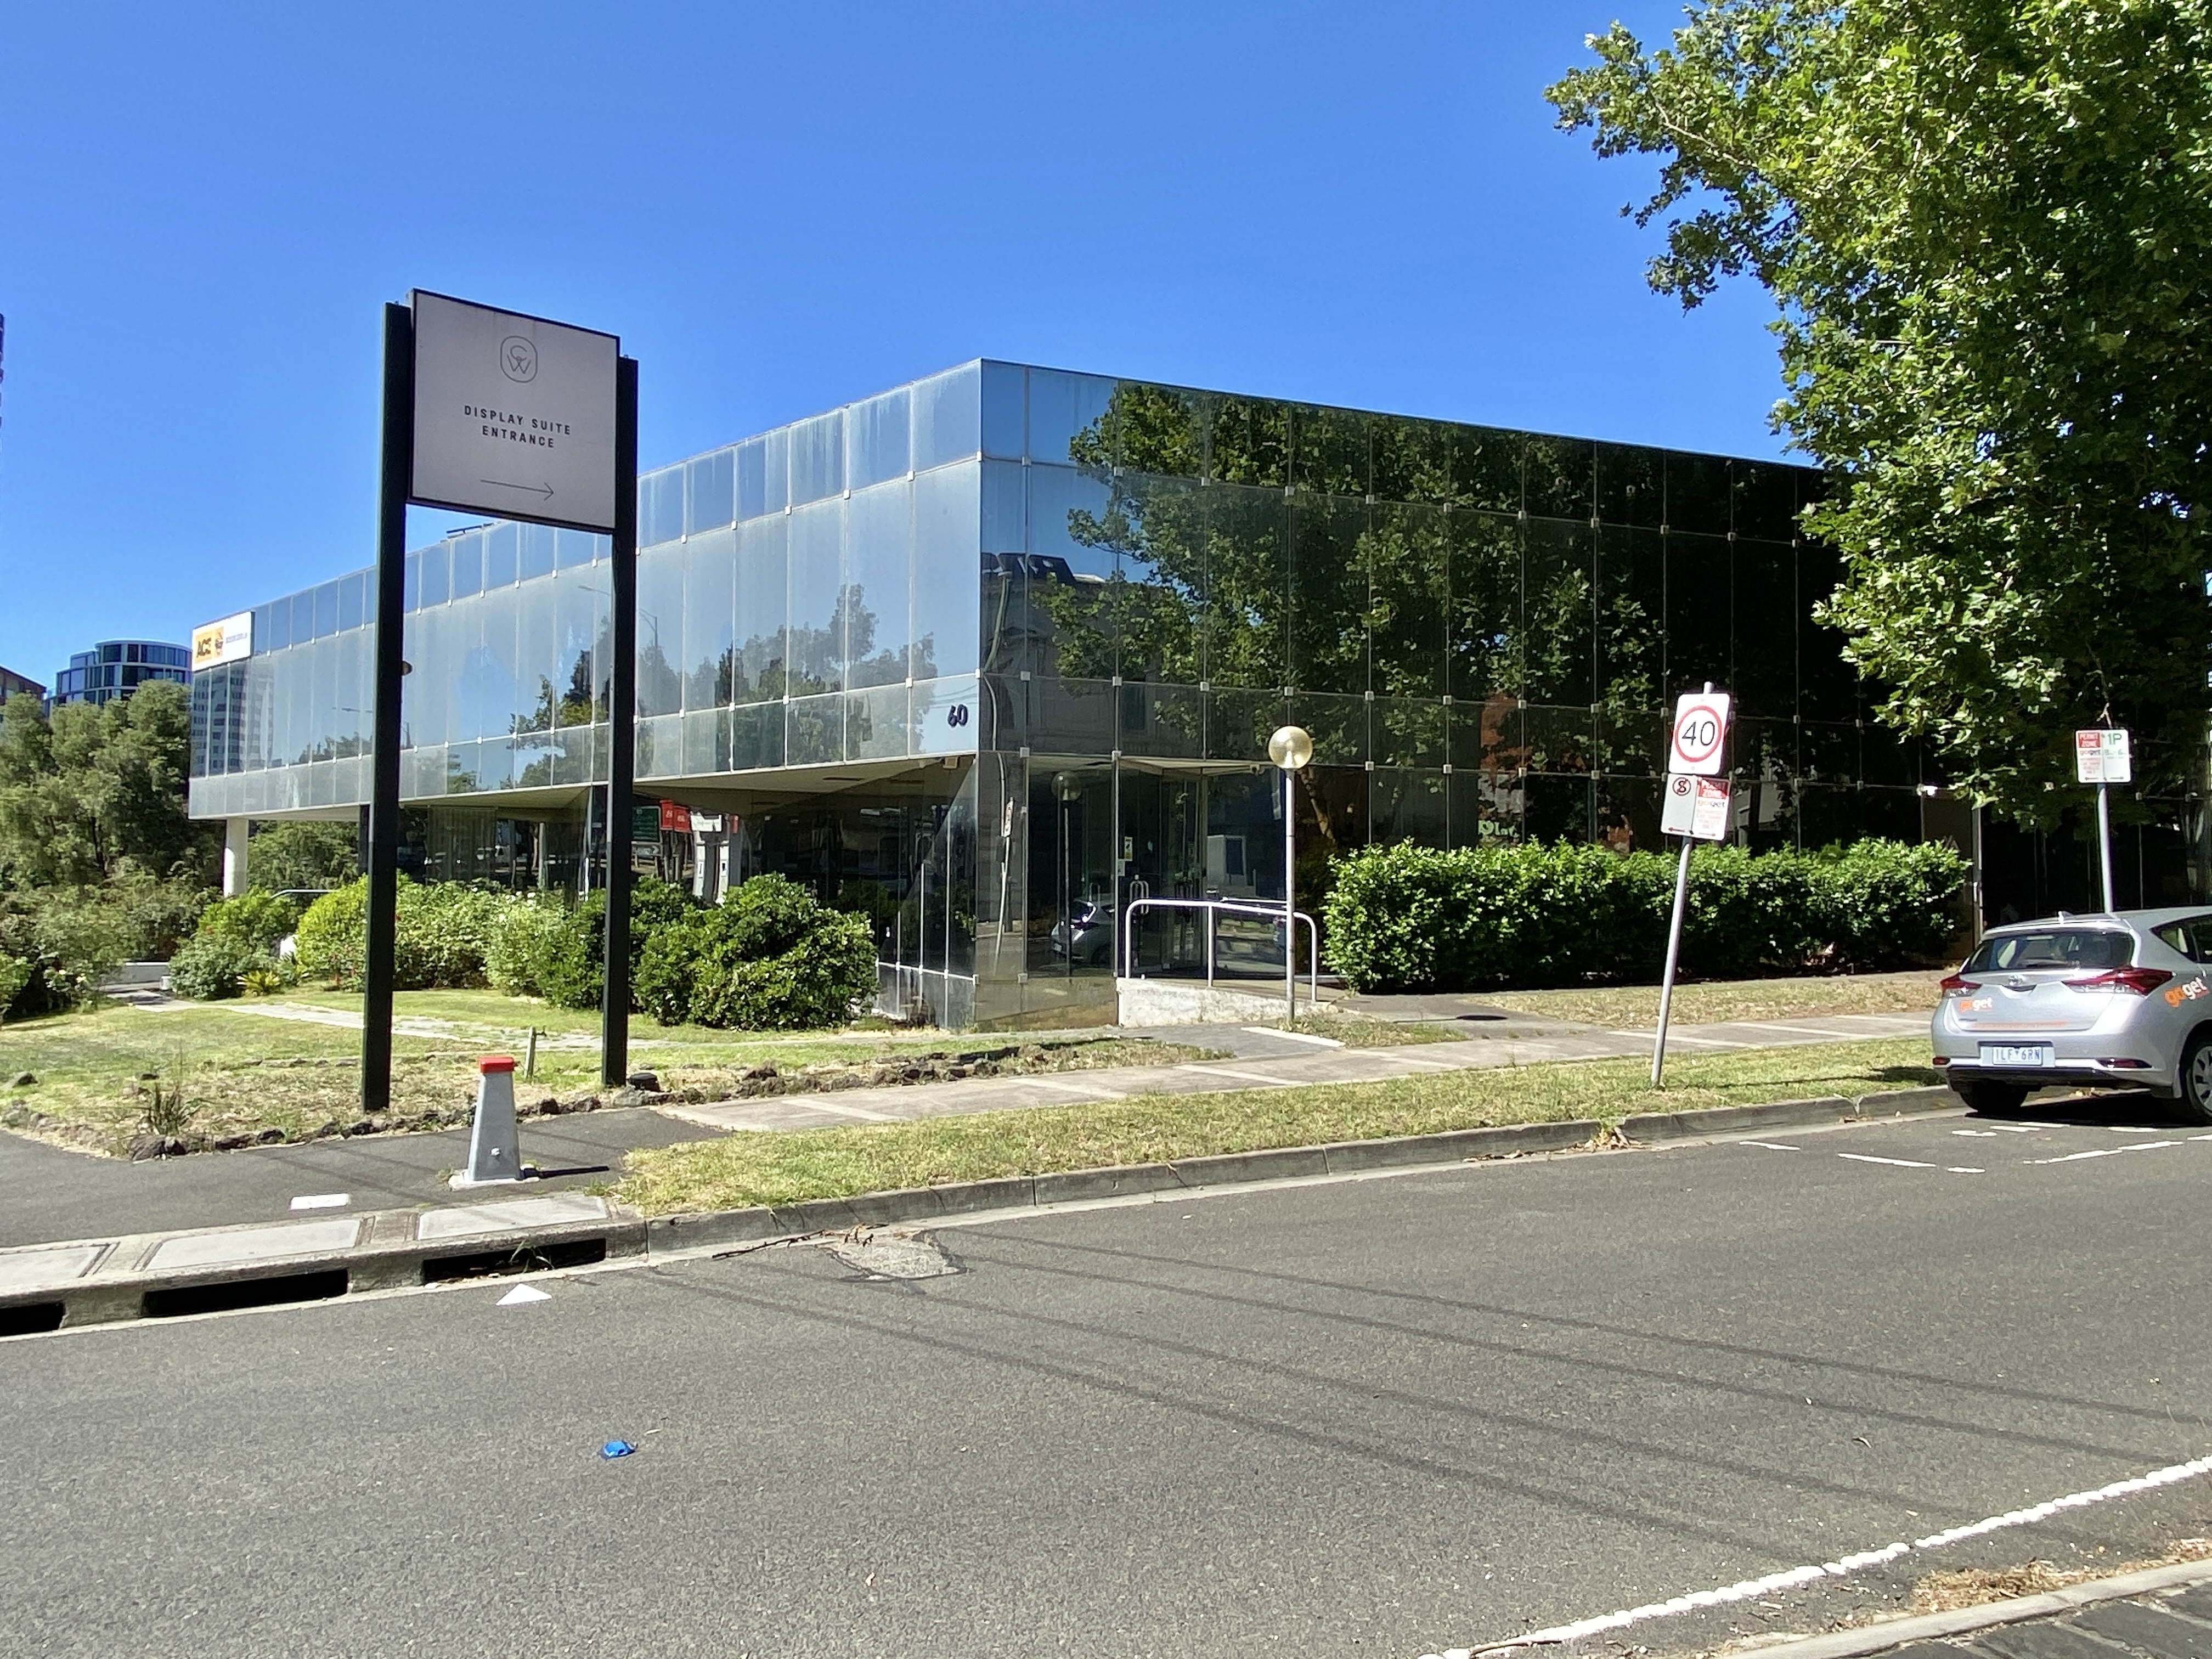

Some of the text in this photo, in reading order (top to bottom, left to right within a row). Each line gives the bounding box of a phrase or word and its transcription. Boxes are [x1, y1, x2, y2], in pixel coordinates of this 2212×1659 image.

[464, 405, 571, 435] DISPLAY SUITE
[482, 425, 555, 448] ENTRANCE
[947, 704, 969, 727] 60
[1681, 720, 1716, 747] 40
[2108, 733, 2122, 745] 1P
[2164, 977, 2208, 1008] goget
